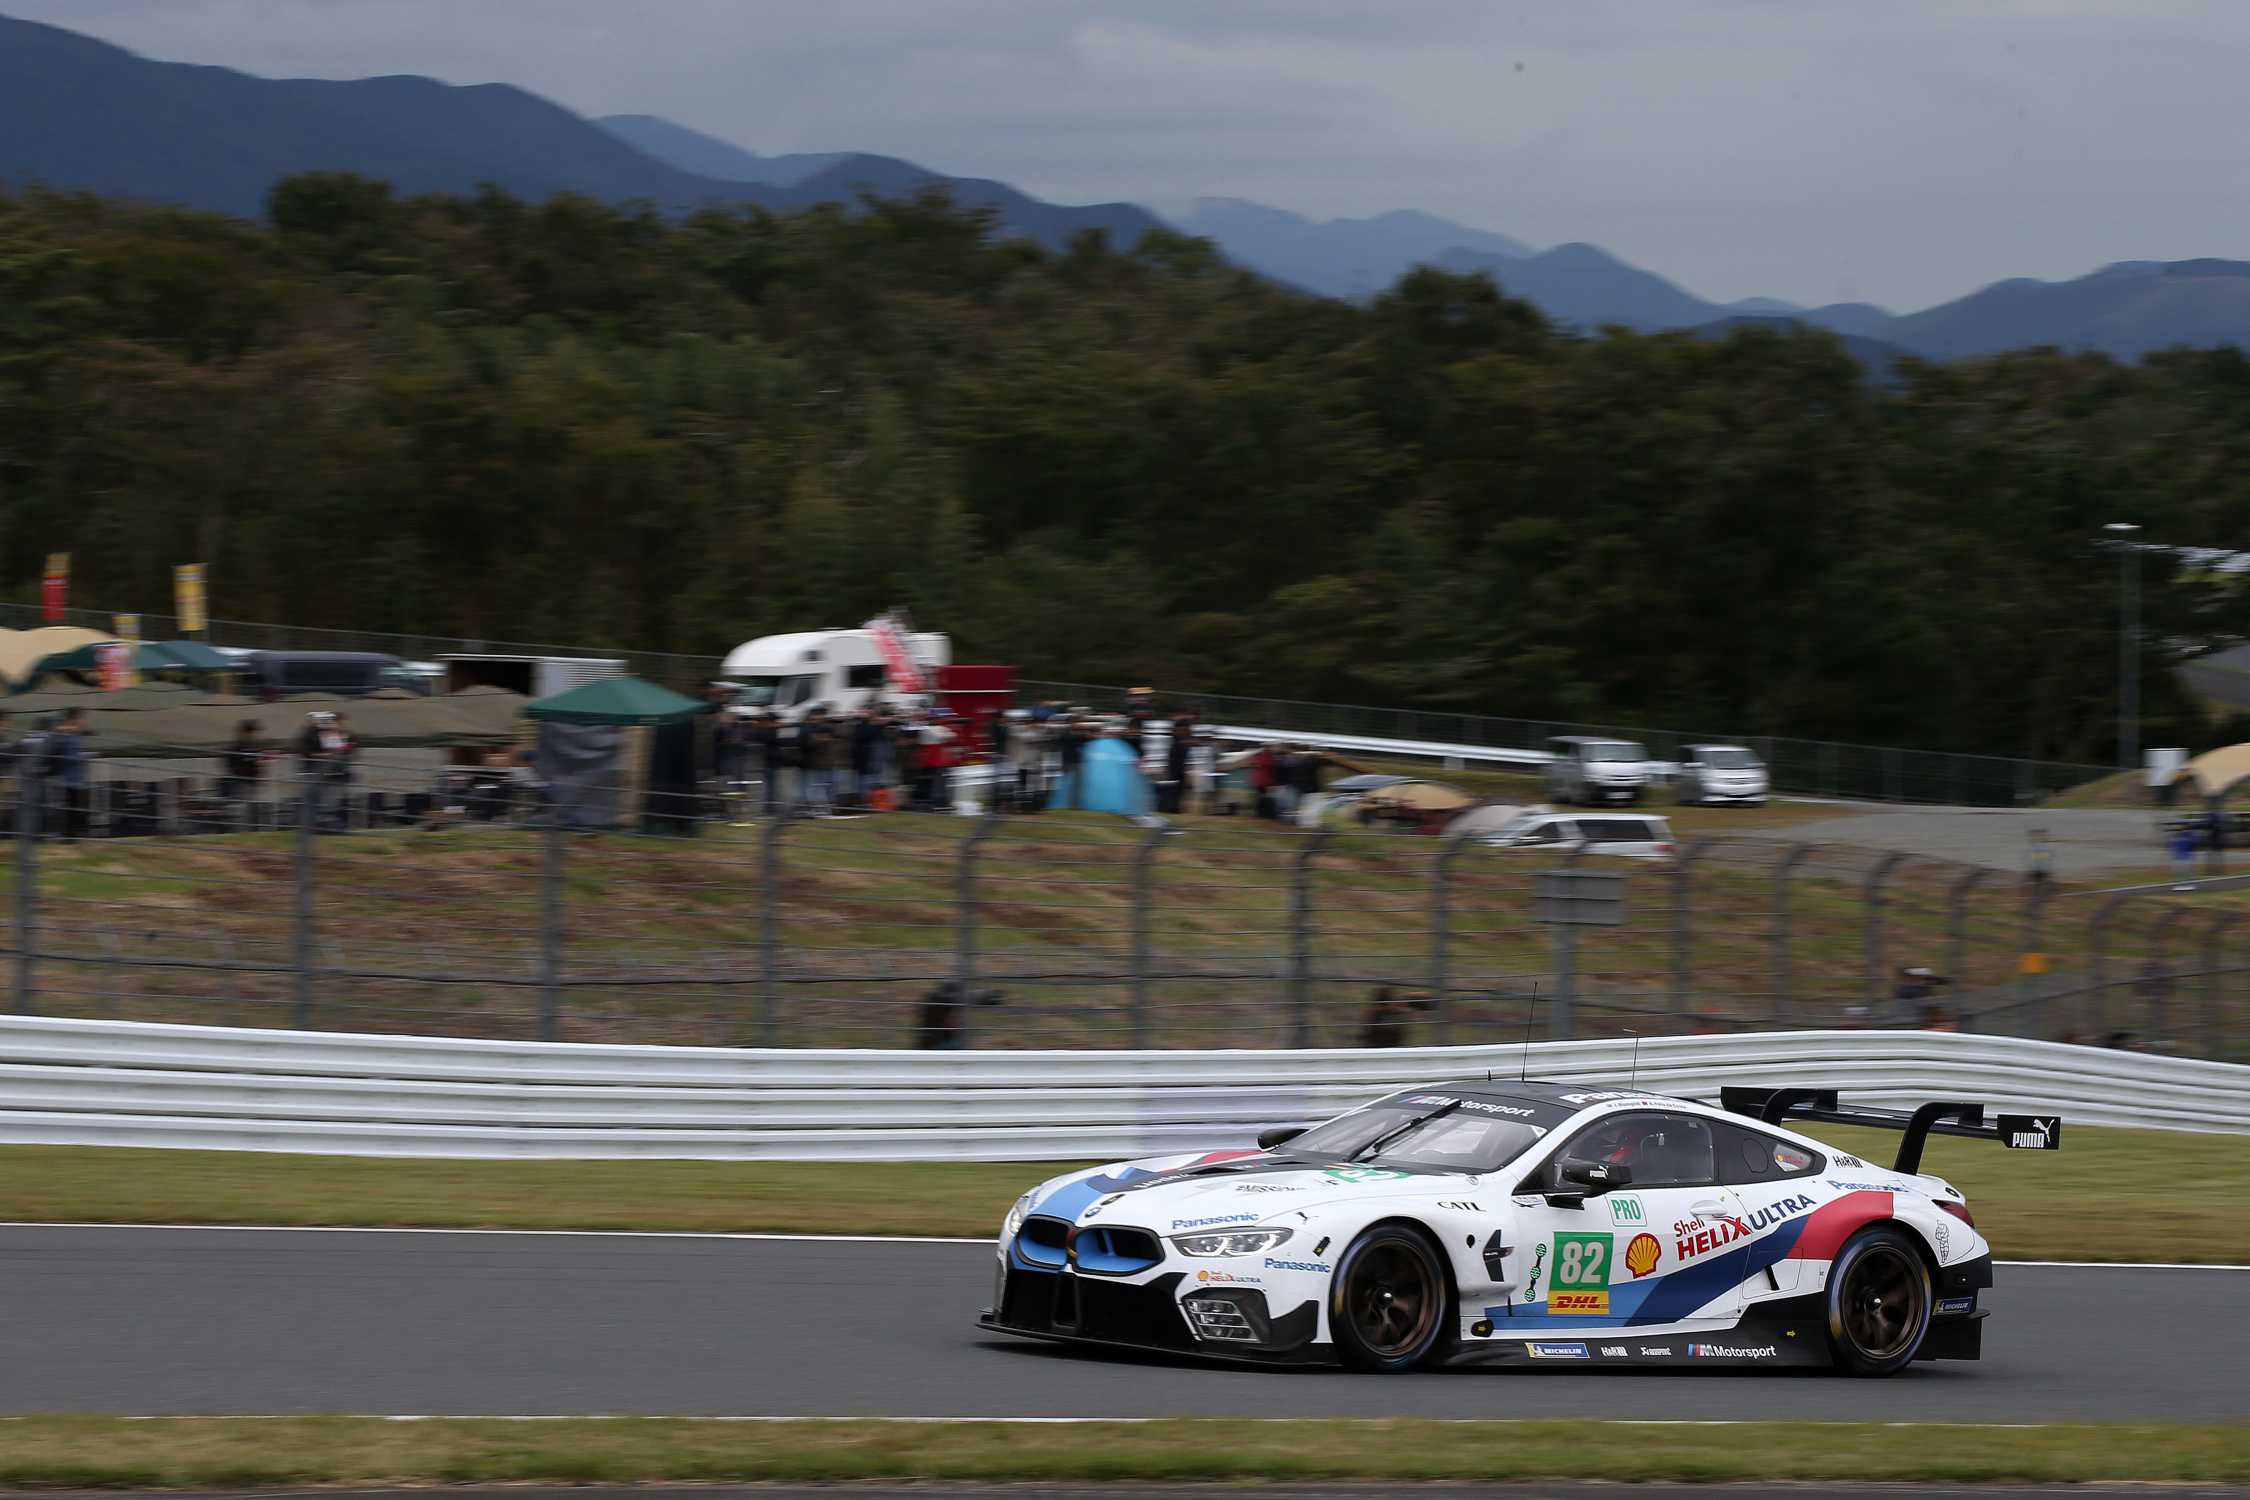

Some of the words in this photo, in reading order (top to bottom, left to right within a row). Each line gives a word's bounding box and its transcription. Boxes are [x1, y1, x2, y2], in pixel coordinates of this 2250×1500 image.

[2012, 1132, 2045, 1148] PUMA
[1437, 1202, 1487, 1212] CATL
[1611, 1199, 1641, 1220] PRO
[1172, 1211, 1259, 1229] Panasonic
[1676, 1216, 1753, 1261] HELIX
[1749, 1194, 1817, 1231] ULTRA
[1264, 1258, 1331, 1273] Panasonic
[1560, 1241, 1605, 1285] 82
[1555, 1296, 1601, 1309] DHL
[1713, 1345, 1777, 1359] Motorsport
